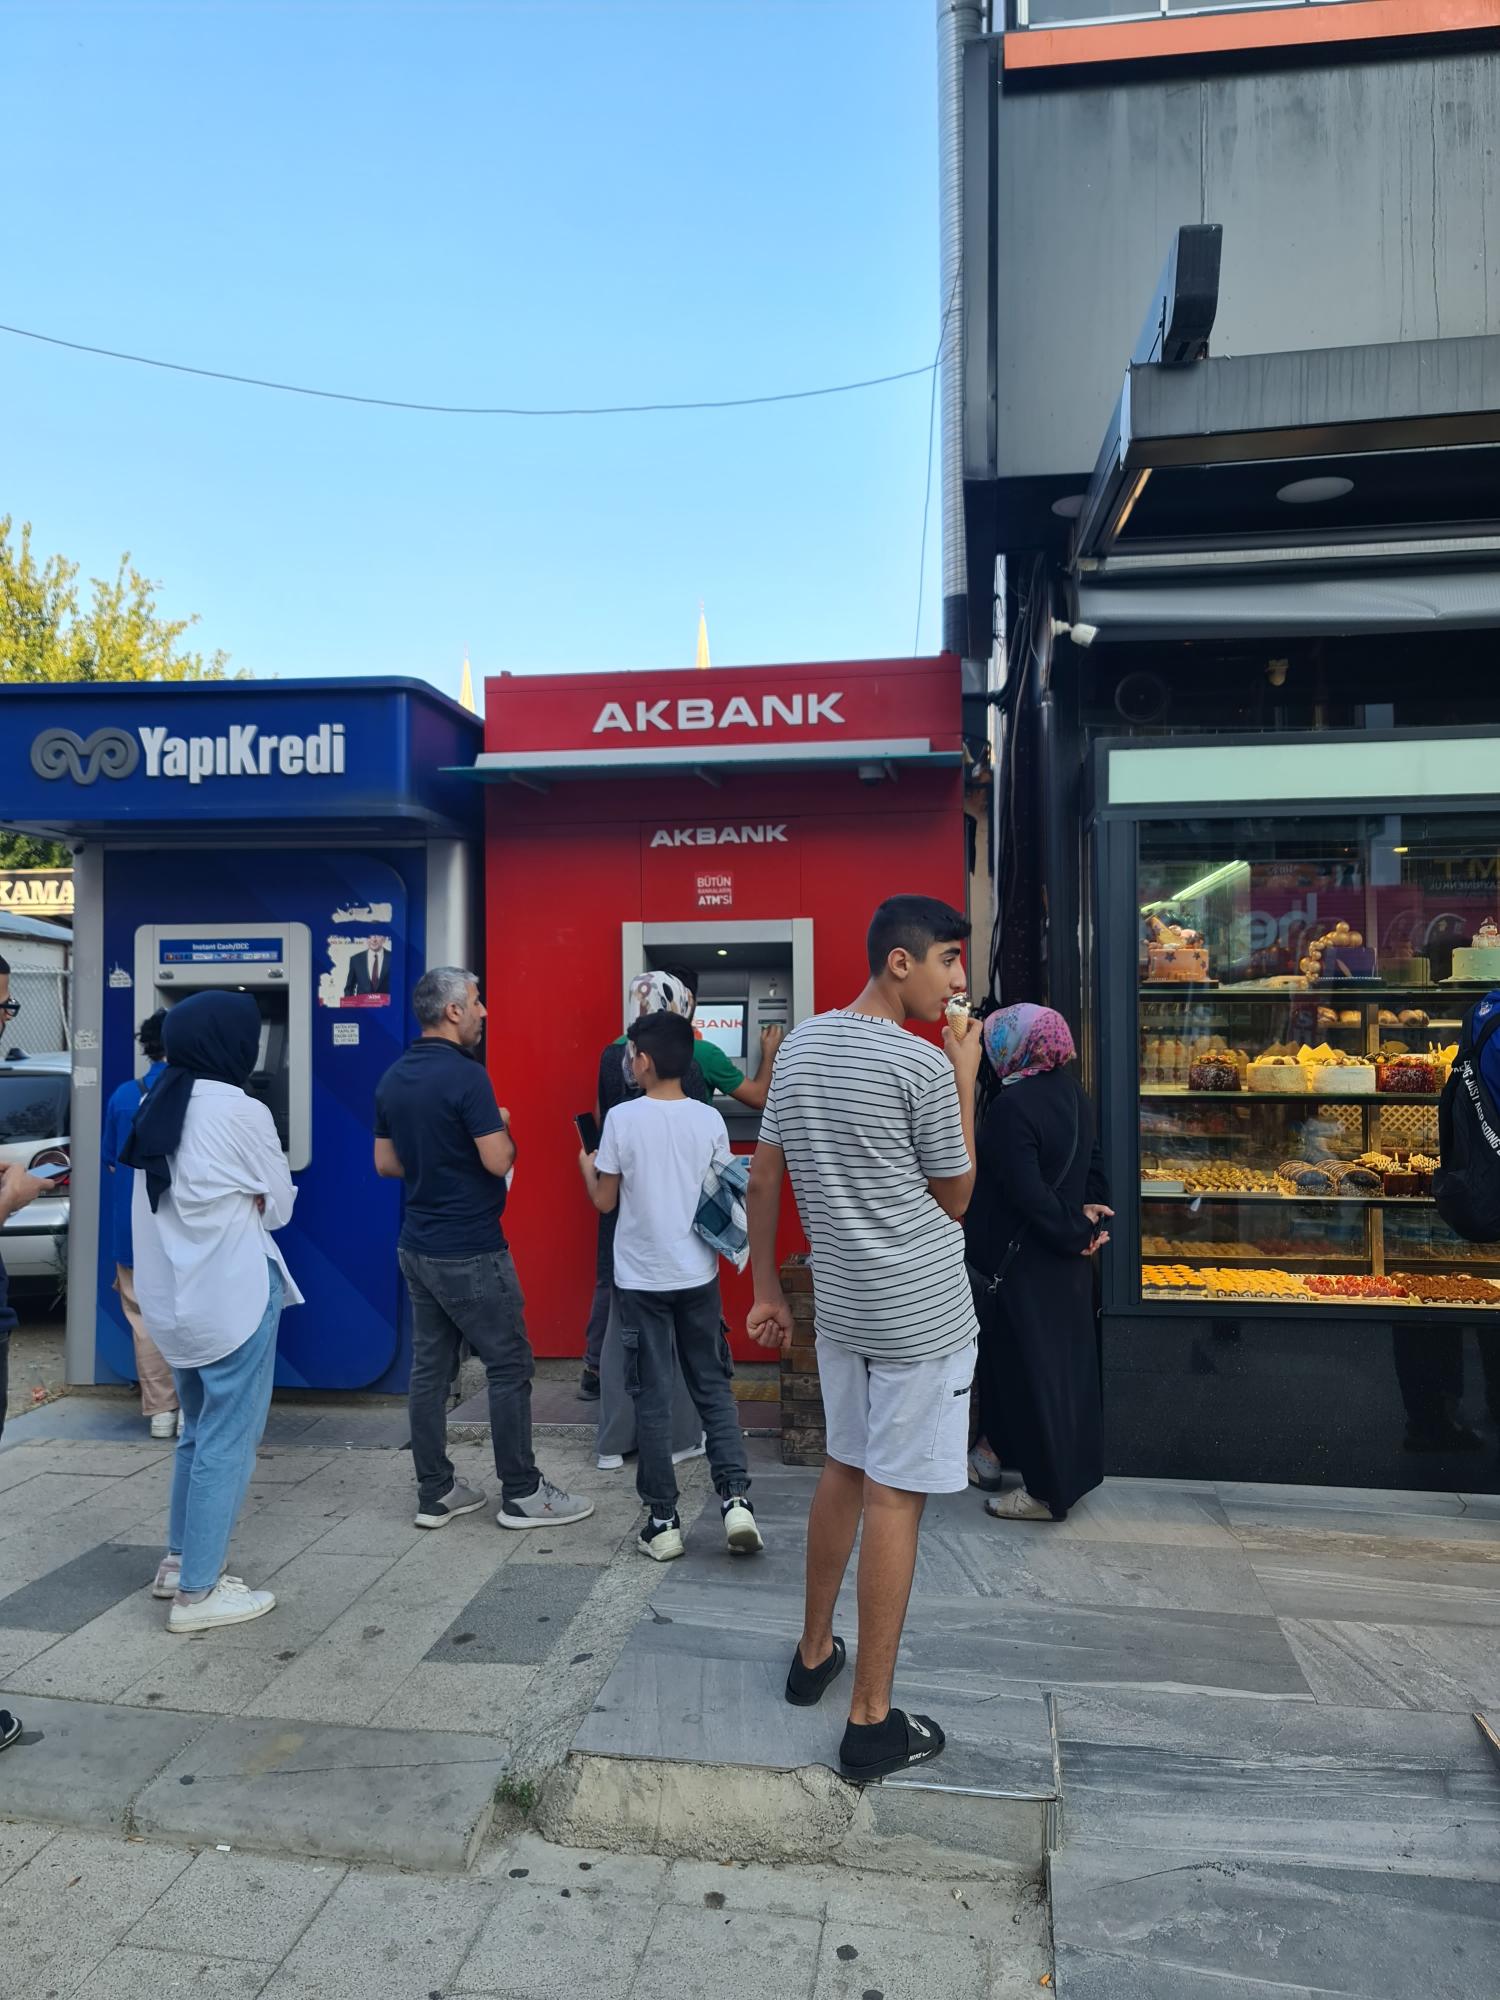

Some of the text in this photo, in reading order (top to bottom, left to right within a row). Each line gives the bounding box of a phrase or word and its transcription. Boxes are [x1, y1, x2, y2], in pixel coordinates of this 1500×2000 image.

[592, 692, 845, 733] AKBANK
[138, 723, 345, 784] YapıKredi
[650, 824, 788, 847] AKBANK
[697, 874, 731, 887] BÜTÜN
[192, 943, 216, 951] Instant
